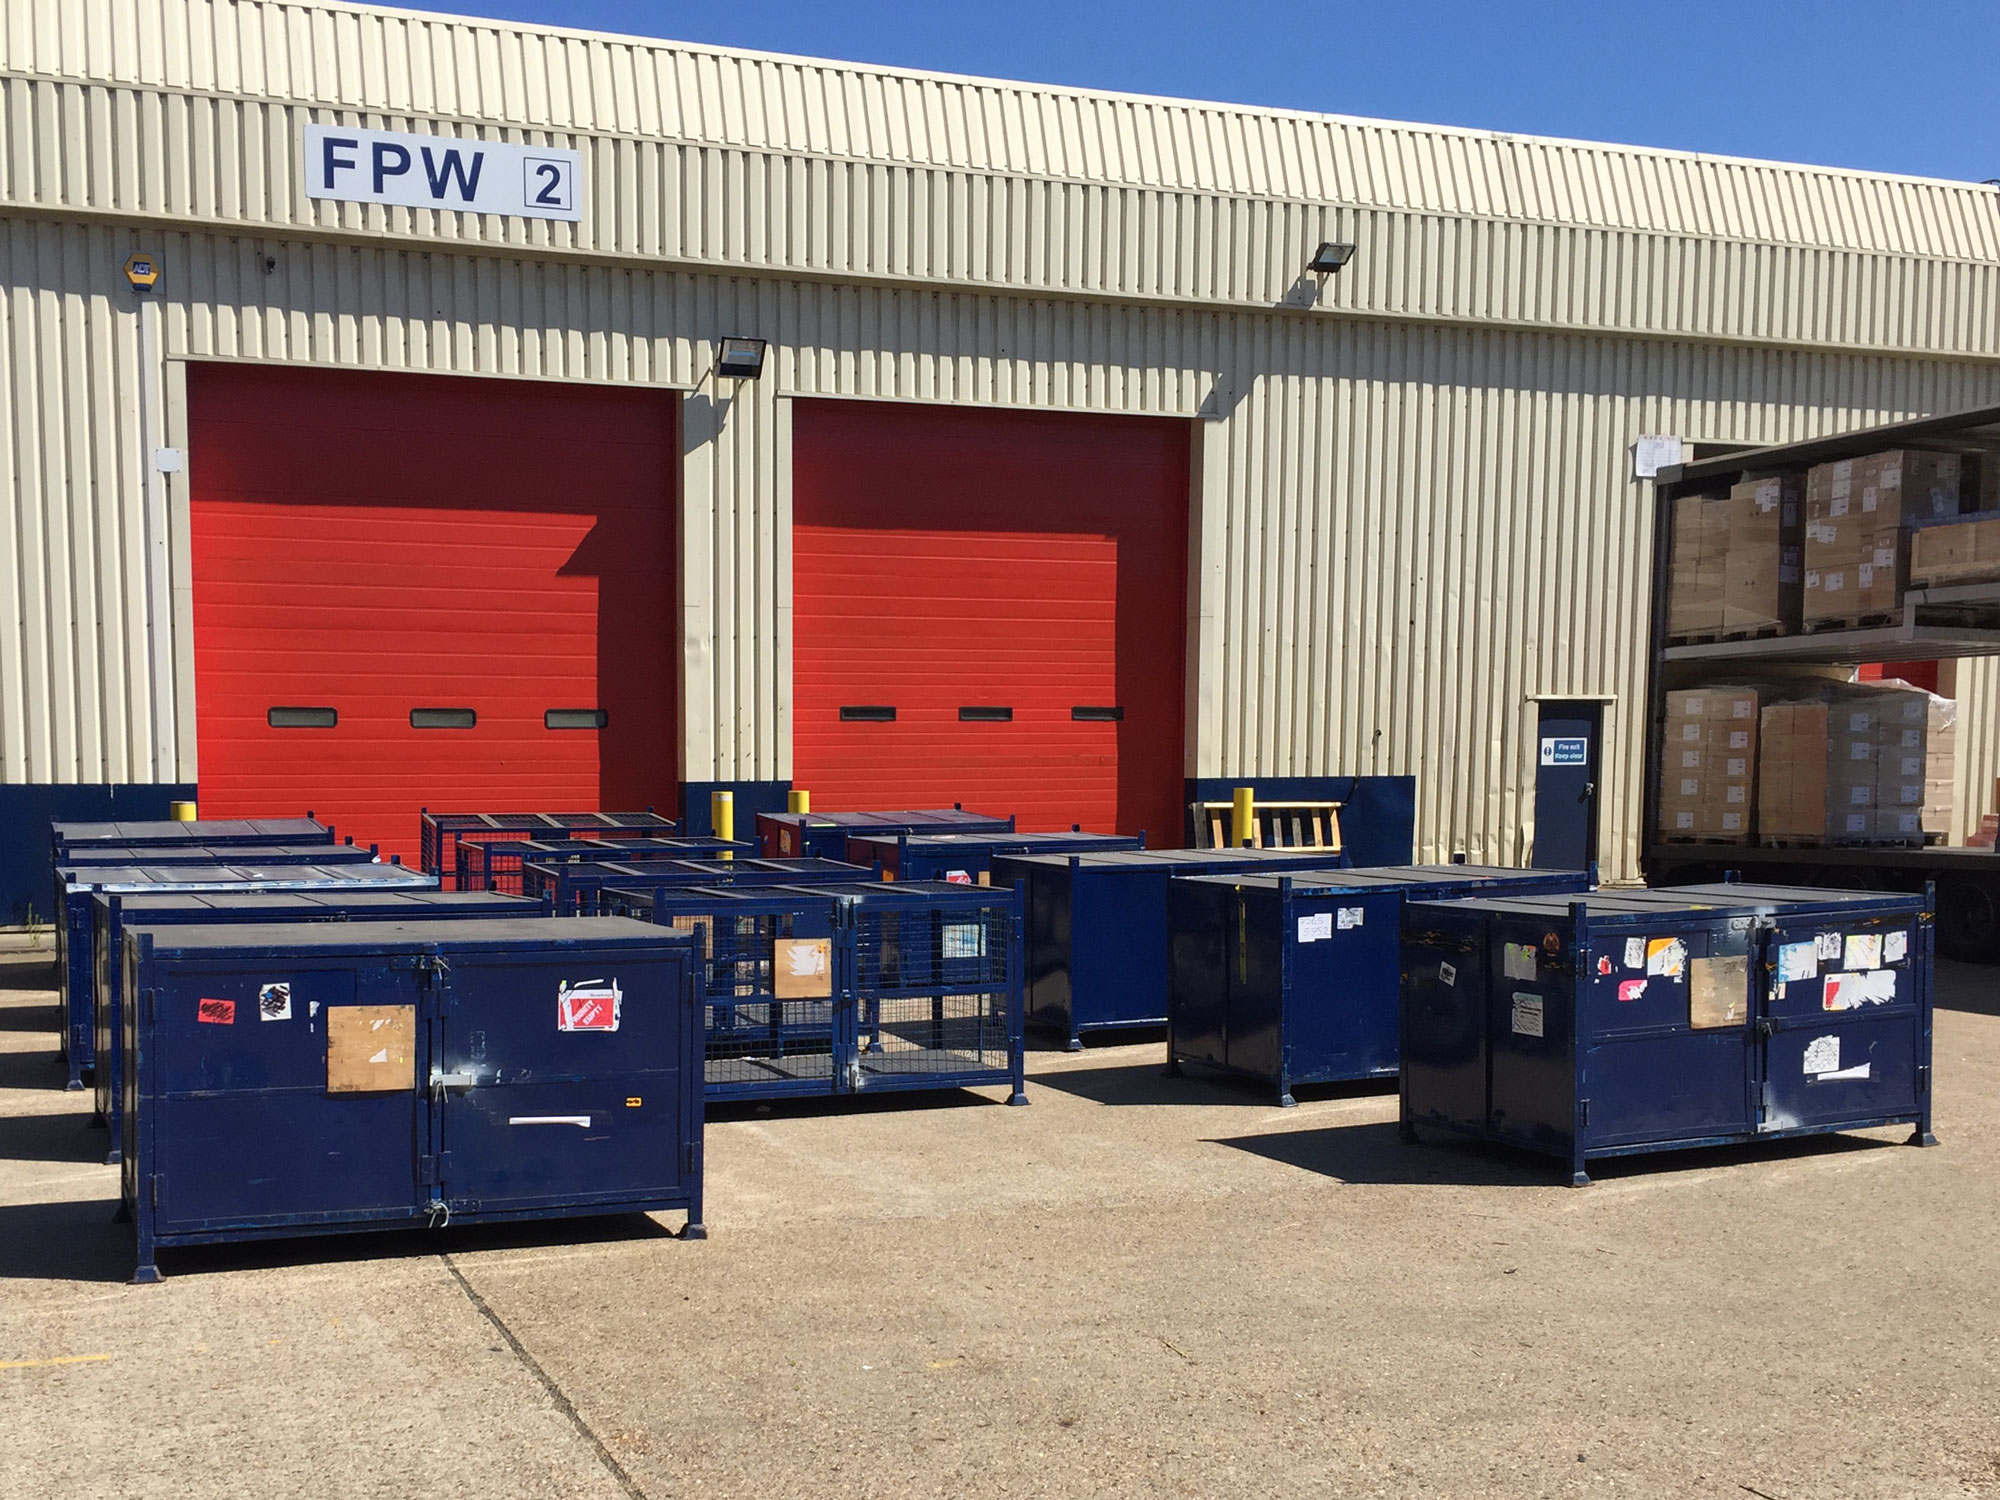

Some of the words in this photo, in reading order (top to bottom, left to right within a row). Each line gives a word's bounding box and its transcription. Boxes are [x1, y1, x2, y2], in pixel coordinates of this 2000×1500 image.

[322, 136, 485, 202] FPW
[535, 164, 561, 205] 2
[133, 263, 150, 274] ADT
[582, 1004, 603, 1025] EMPTY
